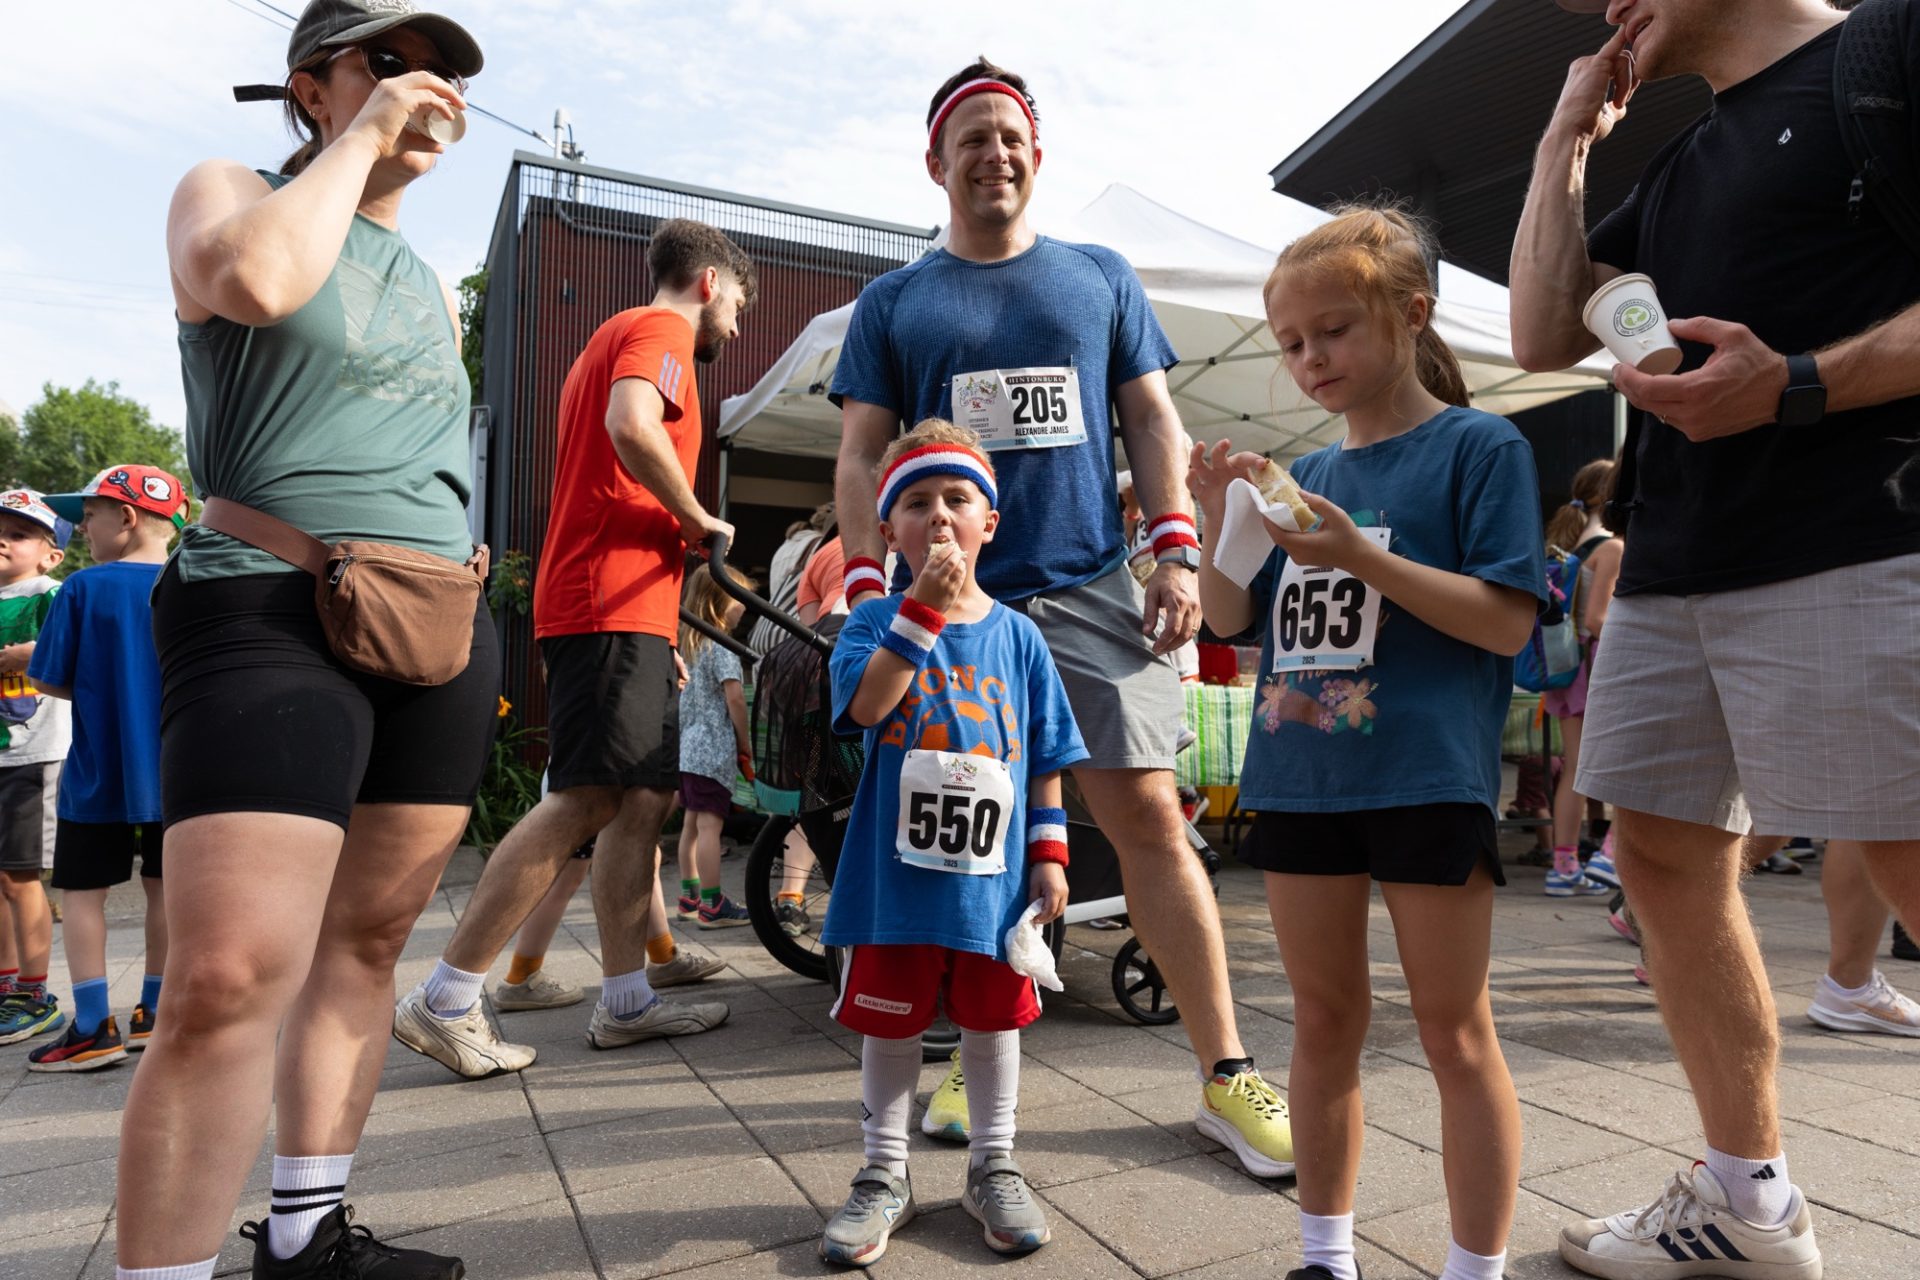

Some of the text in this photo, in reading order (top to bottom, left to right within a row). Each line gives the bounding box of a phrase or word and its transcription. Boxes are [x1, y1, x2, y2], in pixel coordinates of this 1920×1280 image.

[1009, 376, 1064, 384] HINTONBURG
[1011, 386, 1067, 424] 205
[1015, 425, 1069, 436] ALEXANDRE JAMES
[1280, 577, 1367, 652] 653
[1302, 656, 1316, 665] 2025
[908, 791, 1001, 858] 550
[944, 859, 958, 868] 2025
